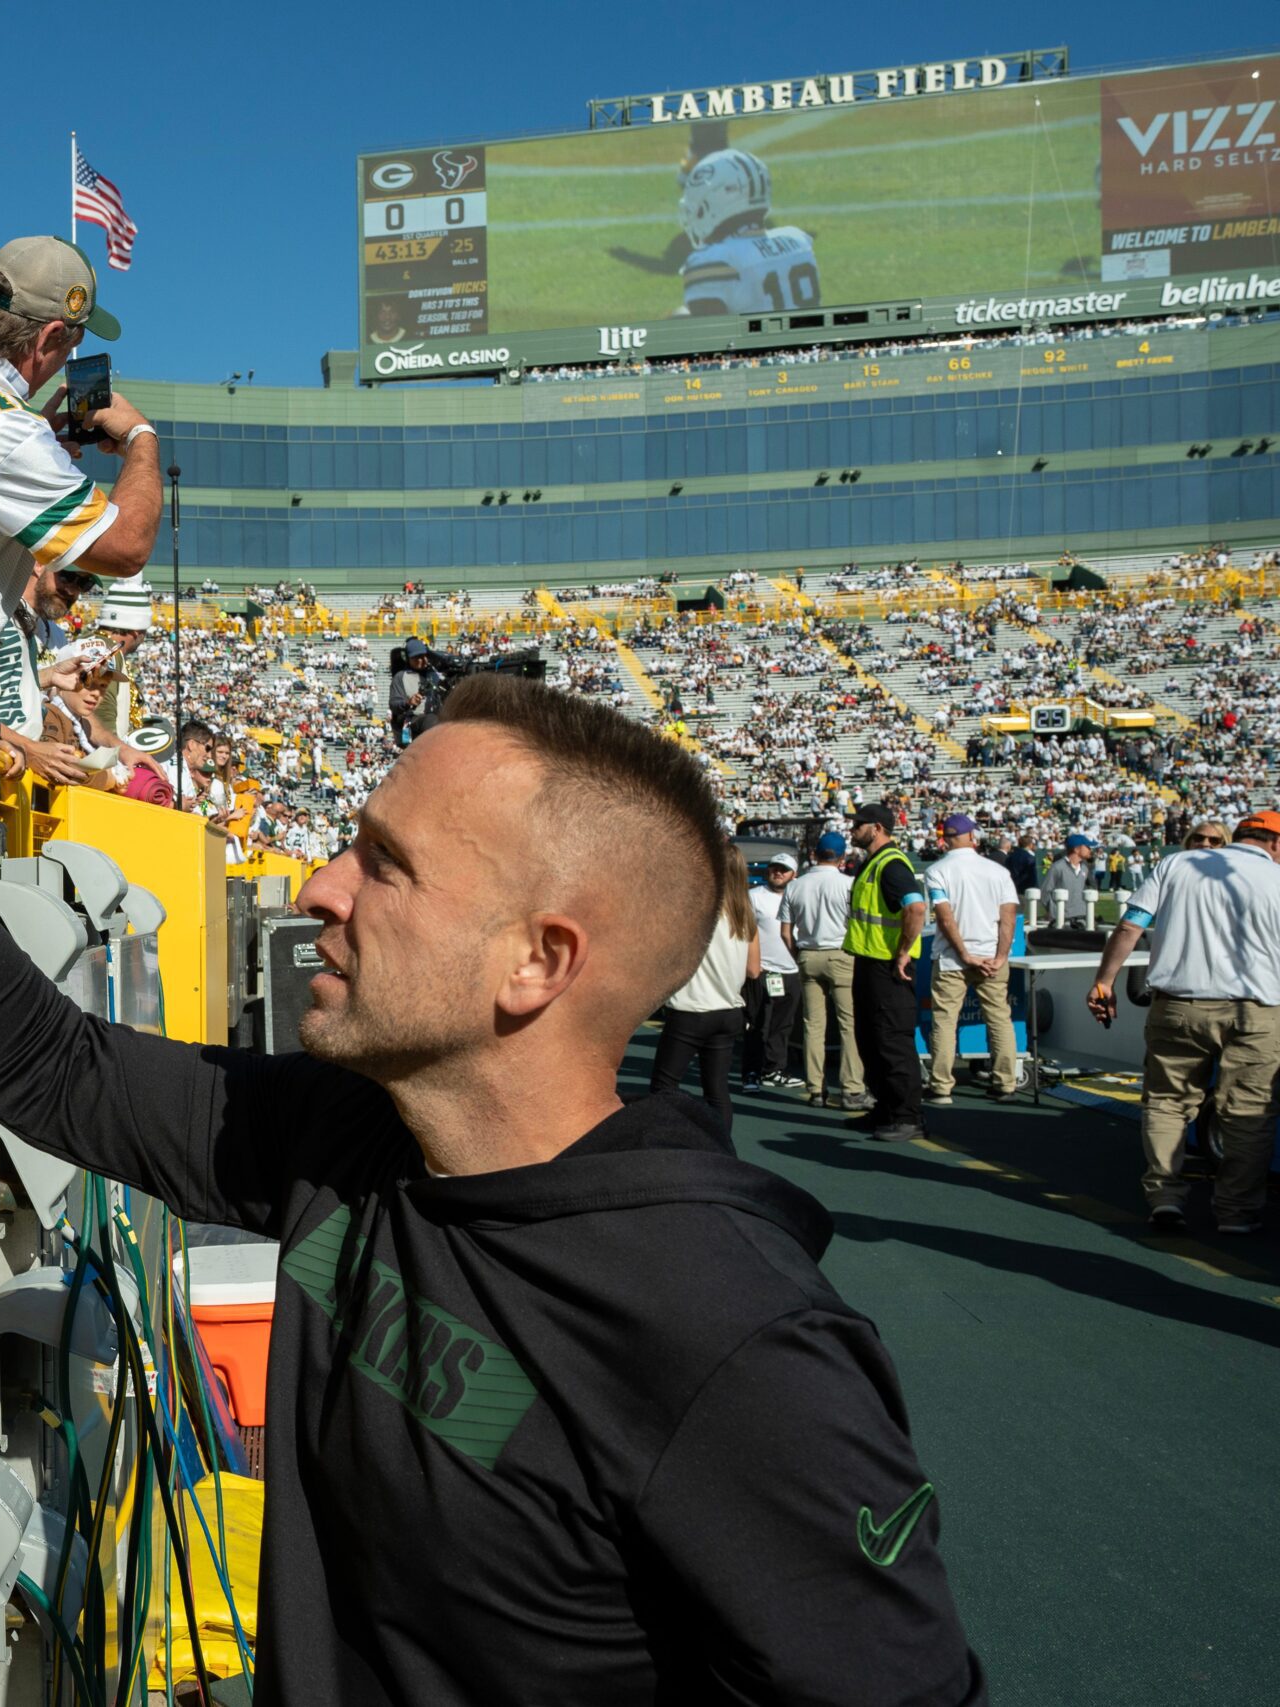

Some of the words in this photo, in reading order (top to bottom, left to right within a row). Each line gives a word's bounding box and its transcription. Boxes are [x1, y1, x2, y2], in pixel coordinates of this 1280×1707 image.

[651, 75, 855, 122] LAMBEAU
[876, 58, 1007, 98] FIELD
[1116, 100, 1280, 157] VIZZ
[1140, 157, 1202, 175] HARD
[385, 203, 404, 230] 0
[445, 197, 464, 225] 0
[415, 230, 448, 240] QUARTER
[1111, 227, 1190, 250] WELCOME
[1192, 224, 1212, 242] TO
[1213, 217, 1280, 240] LAMBEA
[375, 242, 427, 260] 43:13
[452, 280, 487, 295] WICKS
[955, 291, 1128, 325] ticketmaster
[429, 325, 450, 335] TEAM
[598, 326, 647, 356] Lite
[1138, 341, 1150, 354] 4
[374, 350, 444, 375] ONEIDA
[448, 347, 510, 366] CASINO
[948, 357, 971, 371] 66
[1044, 349, 1066, 363] 92
[777, 371, 788, 384] 3
[863, 364, 880, 377] 15
[684, 378, 701, 390] 14
[1037, 710, 1063, 727] 25
